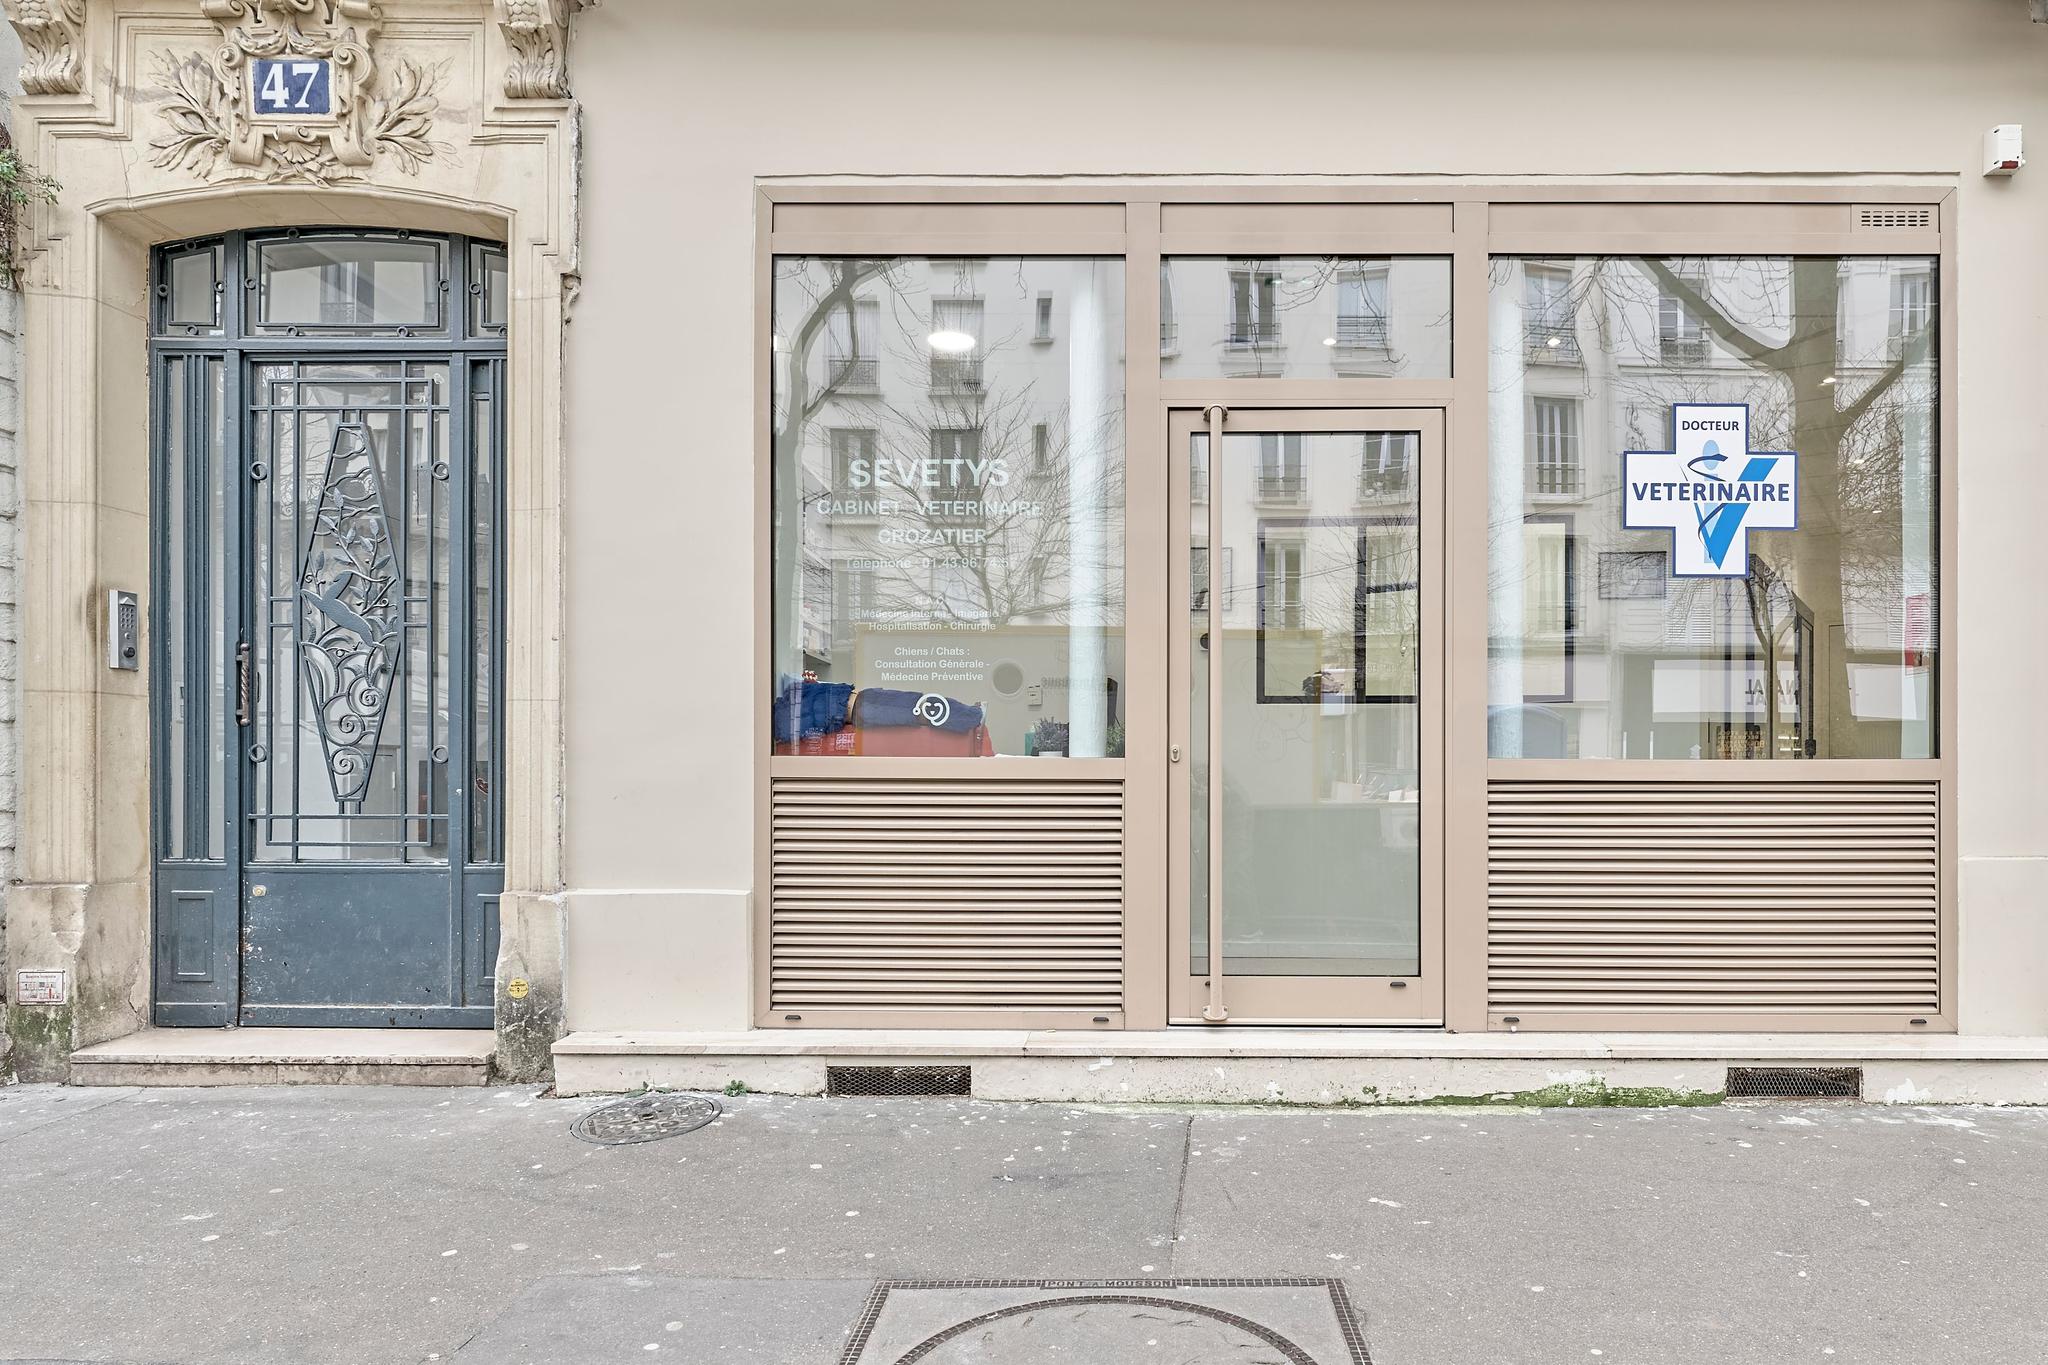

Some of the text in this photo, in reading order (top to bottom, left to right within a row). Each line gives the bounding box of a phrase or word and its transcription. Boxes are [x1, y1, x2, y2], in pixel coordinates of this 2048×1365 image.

[261, 63, 320, 108] 47
[1681, 420, 1740, 431] DOCTEUR
[850, 458, 1009, 487] SEVETYS
[1632, 482, 1790, 502] VETERINAIRE
[816, 500, 901, 515] CABINET
[878, 528, 987, 543] CROZATIER
[868, 621, 942, 633] Hospitalisation
[950, 621, 996, 633] Chirurgie
[894, 647, 929, 656] Chiens
[936, 647, 965, 656] Chats
[874, 660, 937, 669] Consultation
[938, 660, 985, 669] Générale
[881, 671, 984, 681] Médecine Préventive
[1105, 1280, 1172, 1288] MOUSSON
